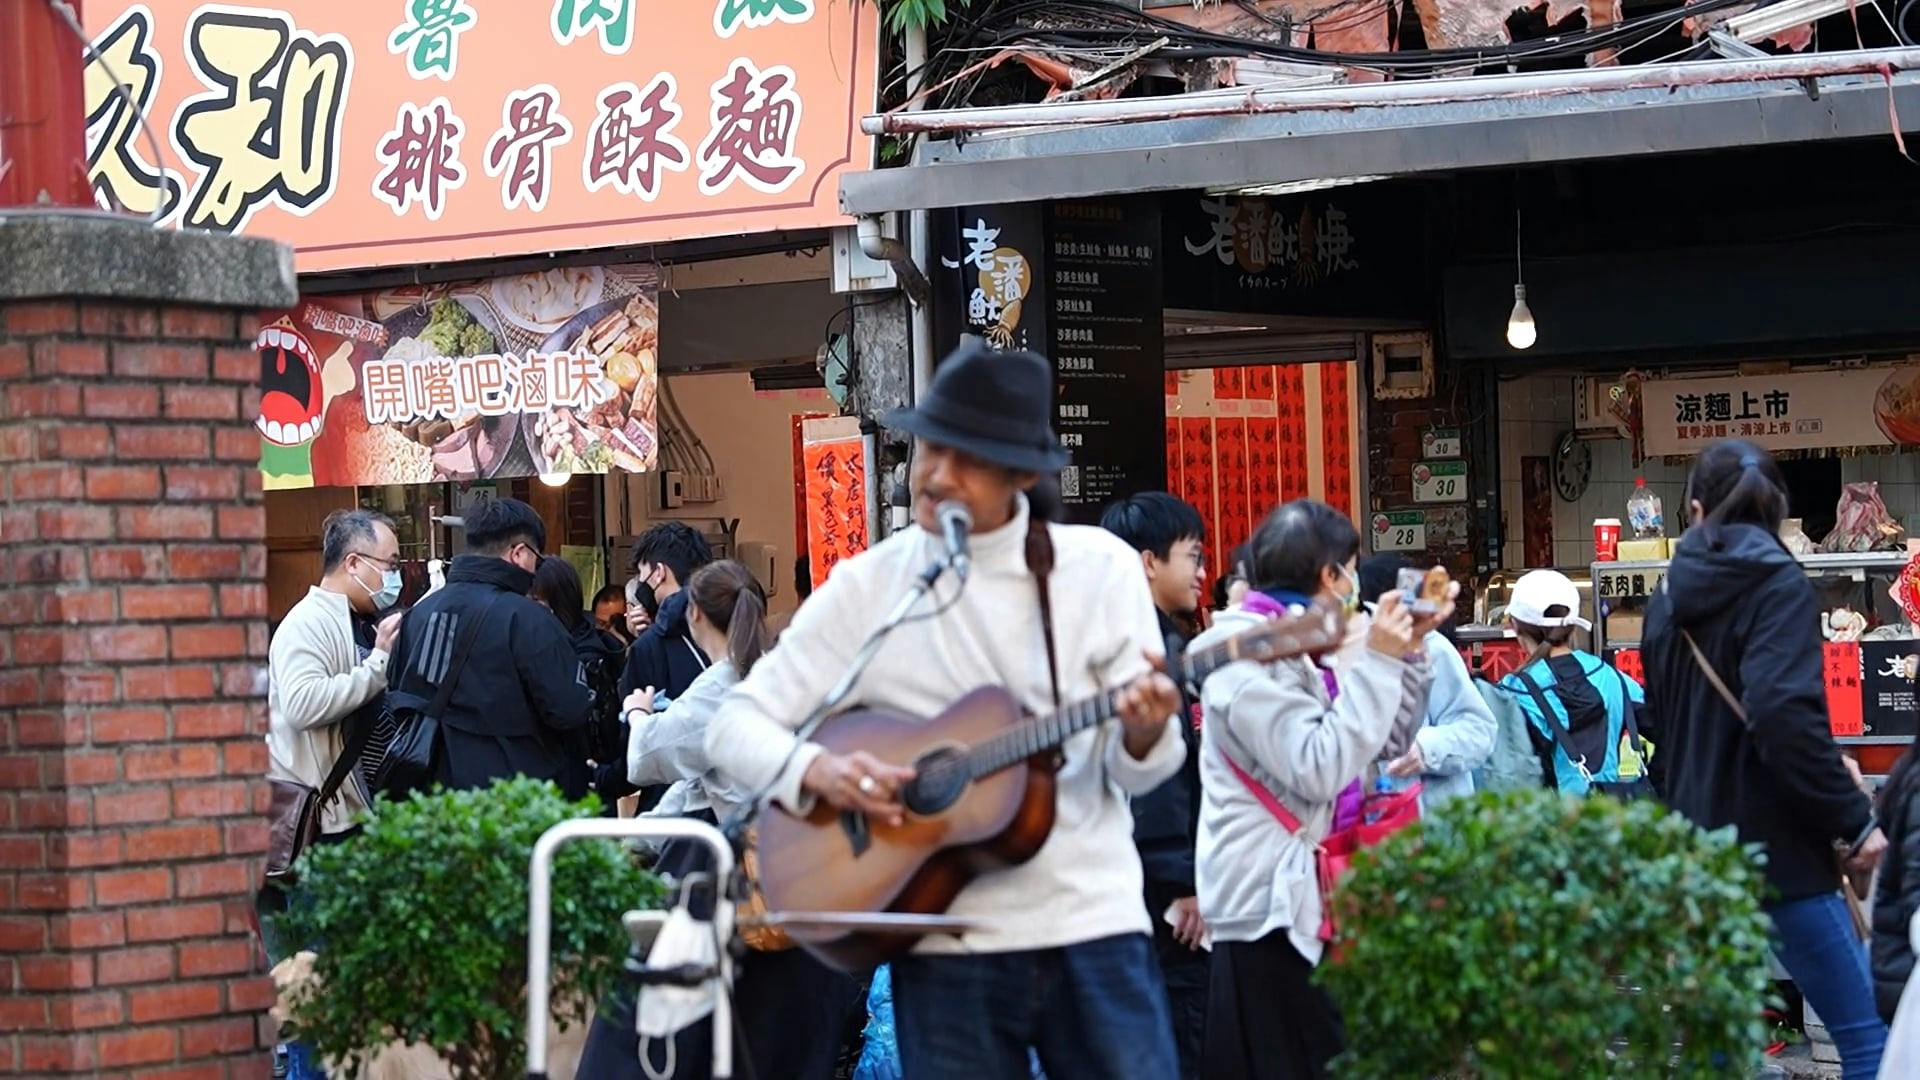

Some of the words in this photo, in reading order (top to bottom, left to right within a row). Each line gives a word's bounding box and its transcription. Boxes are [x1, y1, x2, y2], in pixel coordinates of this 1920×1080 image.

[378, 65, 798, 213] 排骨酥麵
[941, 218, 1024, 352] 老潘魷
[364, 351, 602, 418] 開嘴吧滷味
[1675, 389, 1790, 424] 涼麵上市
[1435, 444, 1448, 454] 30
[1436, 480, 1455, 496] 30
[1396, 529, 1414, 545] 28
